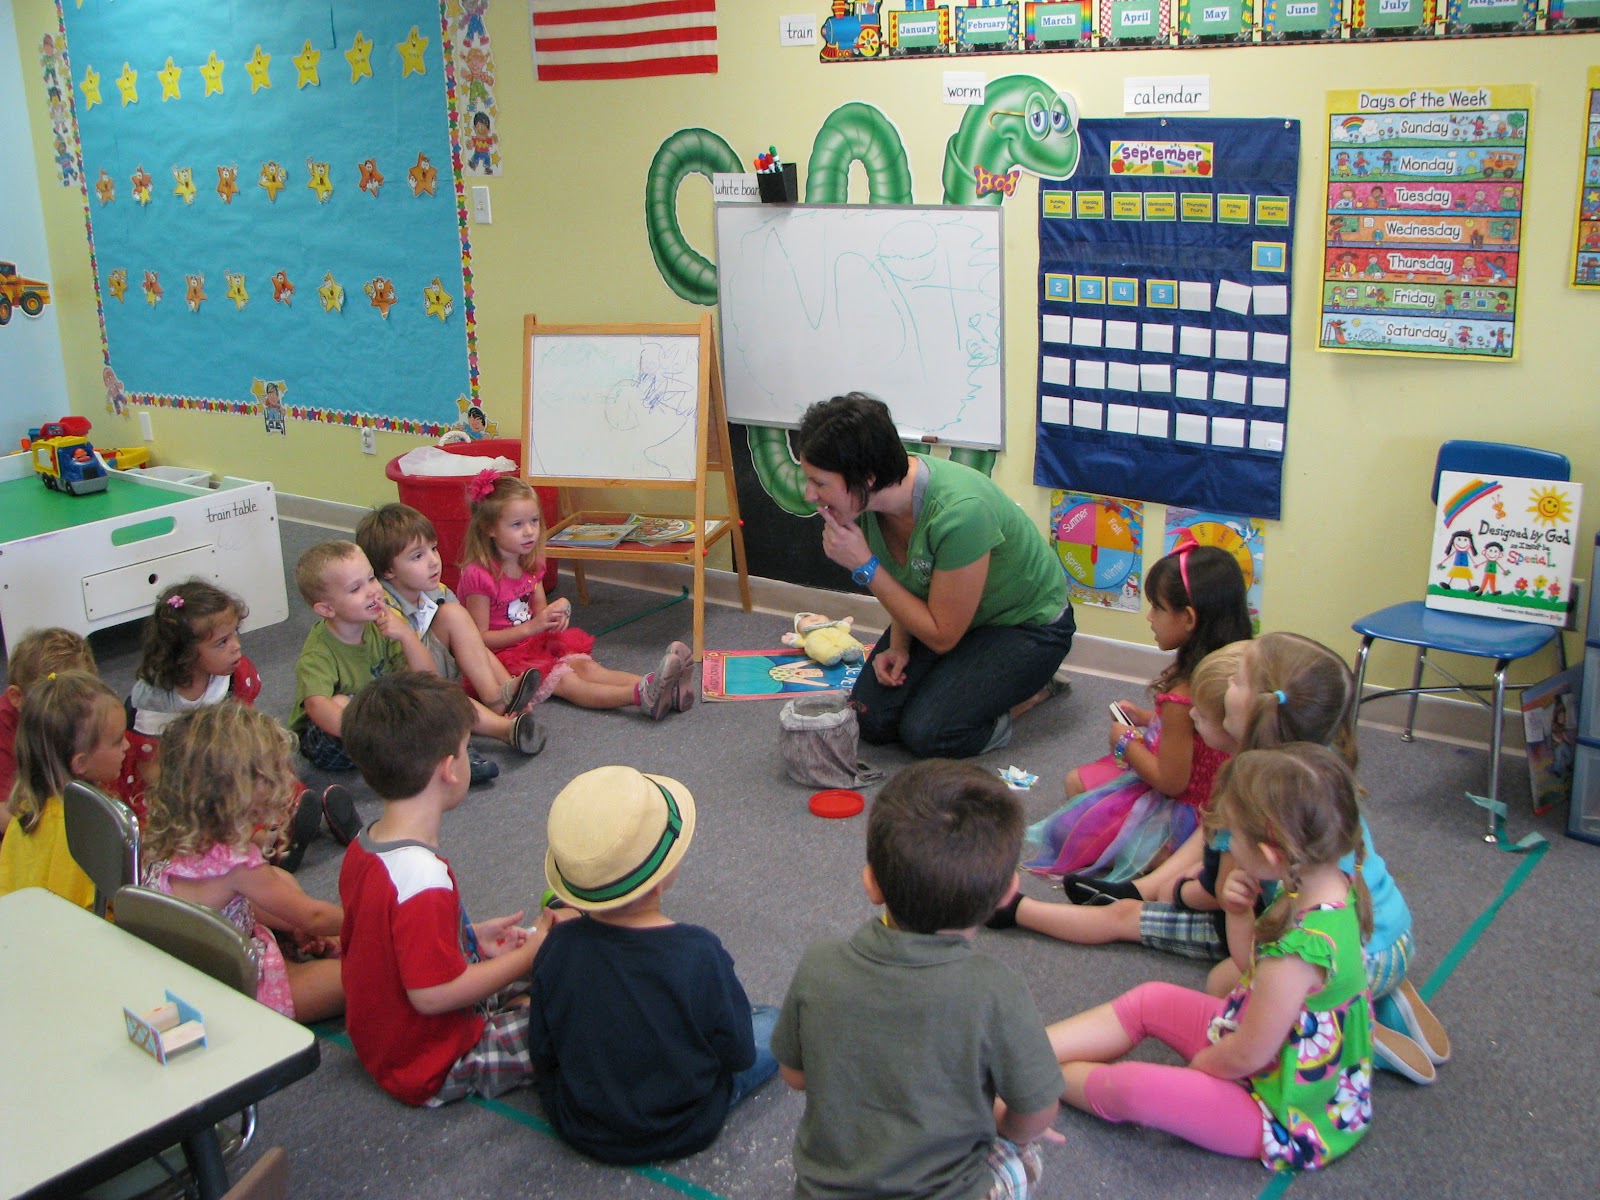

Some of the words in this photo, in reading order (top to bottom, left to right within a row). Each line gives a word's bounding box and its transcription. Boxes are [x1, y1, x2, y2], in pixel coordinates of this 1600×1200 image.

[1286, 4, 1317, 15] June
[1381, 0, 1408, 11] July
[1042, 16, 1073, 26] March
[1123, 13, 1149, 25] April
[1204, 9, 1228, 21] May
[786, 23, 813, 39] train
[900, 25, 937, 36] January
[967, 20, 1006, 31] February
[947, 86, 982, 98] worm
[1133, 85, 1202, 105] calendar
[1360, 93, 1395, 110] Days
[1400, 91, 1416, 108] of
[1421, 92, 1445, 107] the
[1449, 90, 1487, 107] Week
[1401, 120, 1449, 136] Sunday
[1400, 157, 1454, 174] Monday
[715, 179, 740, 195] white
[741, 179, 760, 196] boar
[1395, 188, 1450, 205] Tuesday
[1386, 222, 1461, 239] Wednesday
[1265, 251, 1272, 262] 1
[1388, 255, 1452, 272] Thursday
[1055, 282, 1063, 293] 2
[1087, 284, 1094, 295] 3
[1119, 286, 1127, 297] 4
[1158, 288, 1166, 299] 5
[1393, 289, 1435, 306] Friday
[1386, 323, 1447, 341] Saturday
[206, 508, 231, 523] train
[233, 498, 258, 516] table
[1062, 507, 1089, 533] Summer
[1107, 517, 1124, 535] Fall
[1478, 519, 1529, 541] Designed
[1530, 529, 1544, 543] by
[1545, 528, 1571, 546] God
[1064, 551, 1087, 579] Spring
[1101, 560, 1126, 581] Winter
